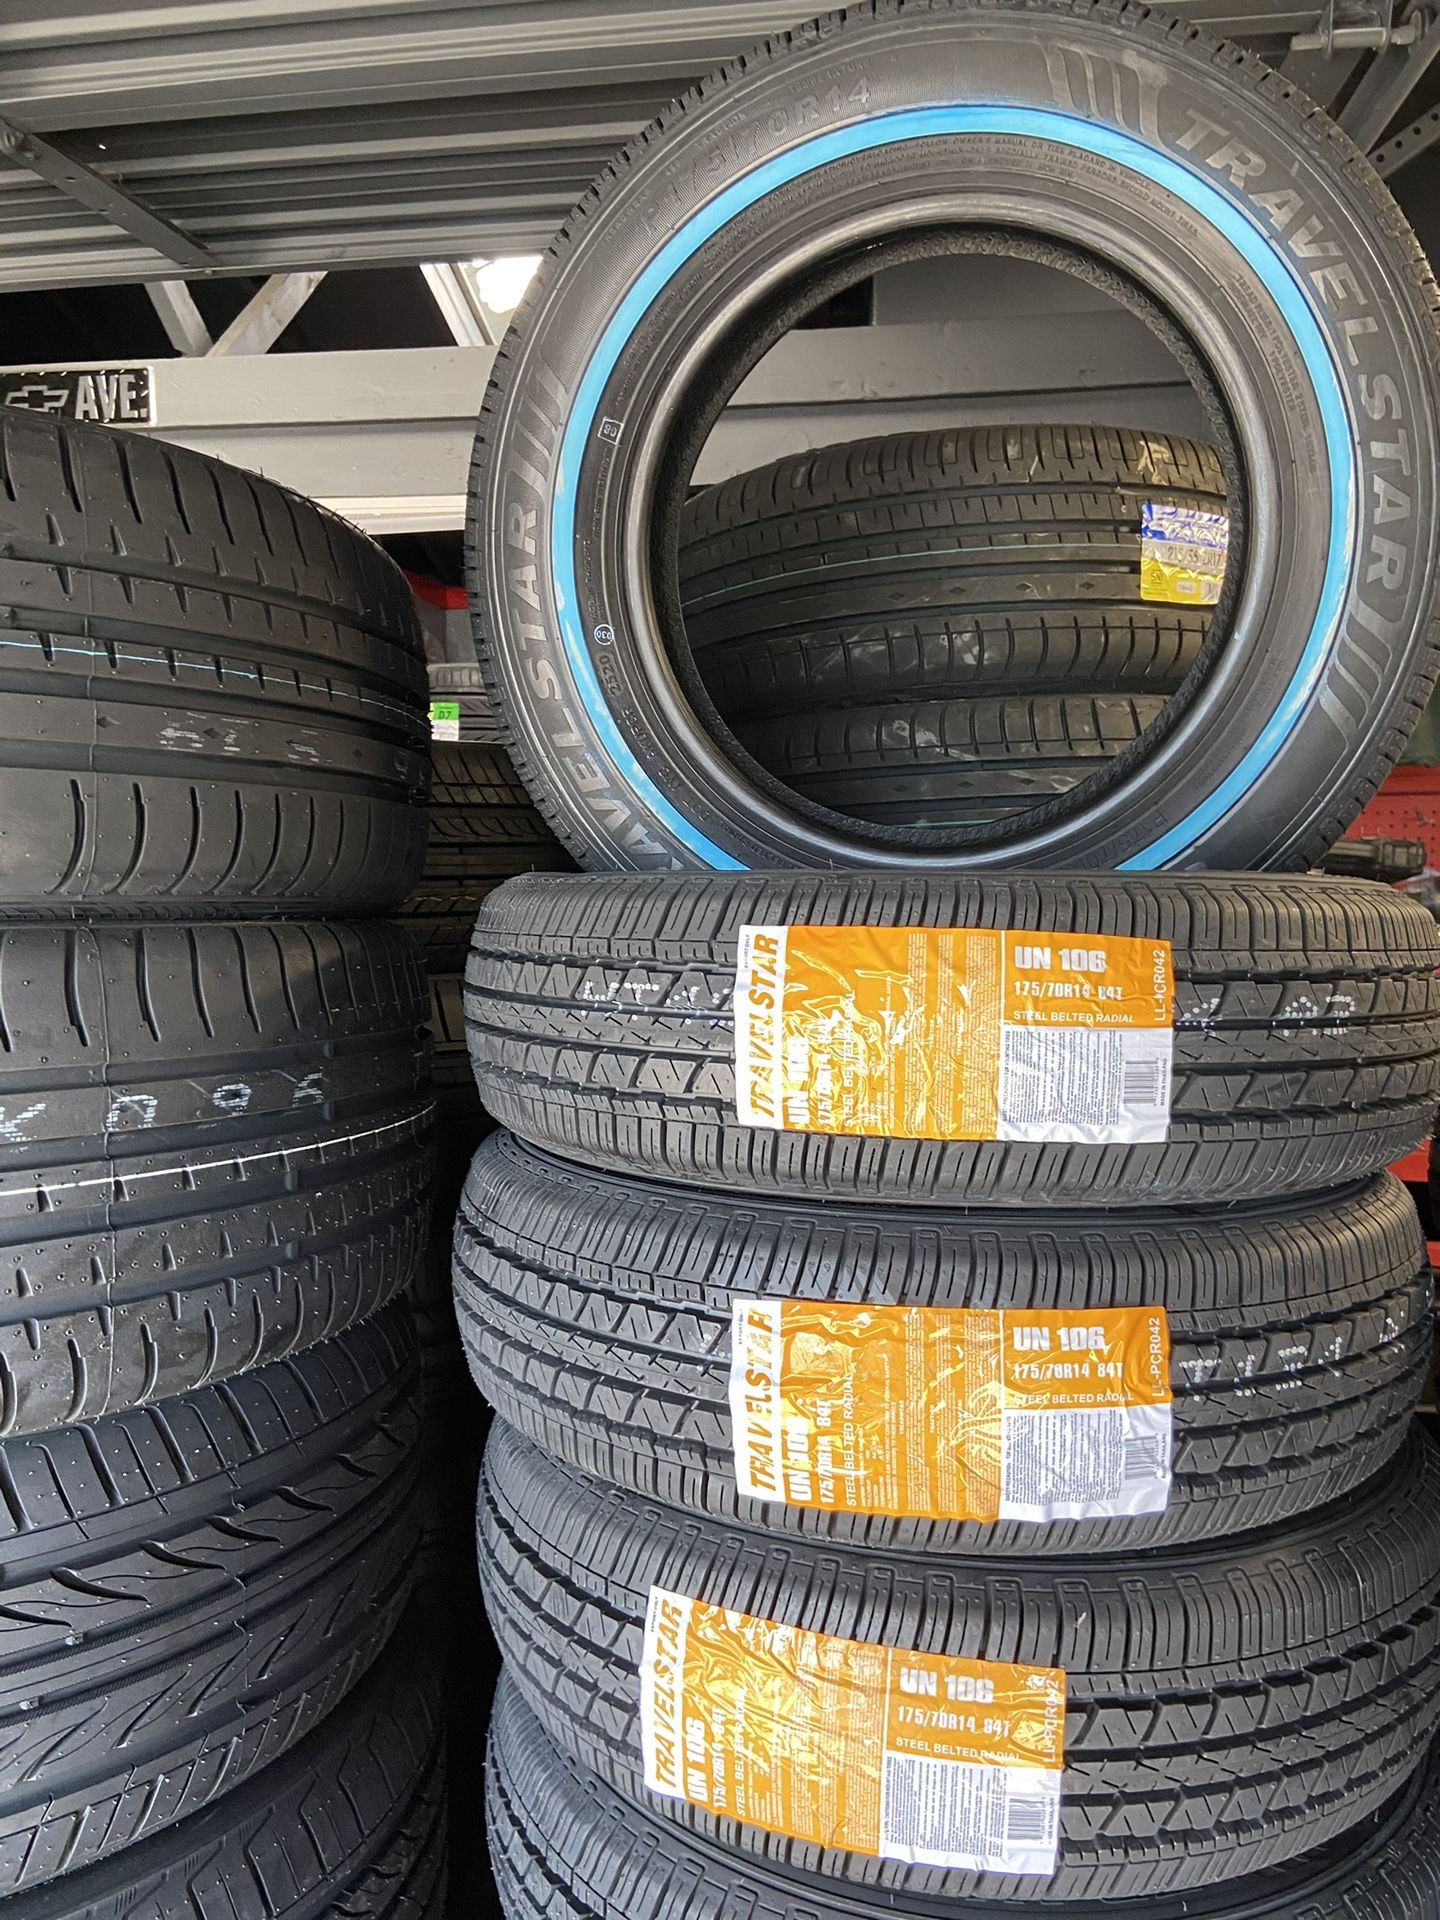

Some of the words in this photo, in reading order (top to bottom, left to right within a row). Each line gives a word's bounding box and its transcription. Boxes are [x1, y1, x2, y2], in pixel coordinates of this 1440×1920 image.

[1176, 108, 1413, 593] TRAVELSTAR
[75, 374, 148, 419] AVE.
[508, 504, 684, 870] AVELSTAR
[597, 652, 622, 697] 2520
[1014, 945, 1051, 971] UN
[1058, 948, 1106, 973] 106
[1014, 980, 1090, 1000] 175/70R14
[749, 933, 778, 1118] TRAVELSTAR
[1014, 1010, 1044, 1022] STEEL
[1050, 1011, 1093, 1023] BELTED
[1095, 1013, 1135, 1024] RADIAL
[788, 1090, 809, 1123] UN
[1014, 1326, 1050, 1351] UN
[1056, 1326, 1105, 1351] 106
[1149, 1316, 1165, 1398] LL-PCR042
[1014, 1363, 1089, 1382] 175/70R14
[1097, 1362, 1124, 1379] 84T
[745, 1307, 776, 1492] TRAVELSTAR
[815, 1399, 832, 1427] 84T
[843, 1374, 854, 1420] RADIAL
[1014, 1393, 1049, 1404] STEEL
[1051, 1393, 1094, 1404] BELTED
[1096, 1391, 1135, 1402] RADIAL
[844, 1423, 855, 1469] BELTED
[787, 1472, 812, 1501] UN
[816, 1436, 835, 1504] 175/70R14
[845, 1474, 857, 1507] STEEL
[653, 1599, 682, 1788] TRAVELSTAR
[900, 1667, 938, 1697] UN
[945, 1674, 995, 1705] 106
[685, 1717, 707, 1764] 106
[897, 1706, 977, 1736] 175/70R14
[982, 1719, 1012, 1738] 84T
[734, 1735, 745, 1781] BELTED
[896, 1737, 930, 1752] STEEL
[932, 1741, 978, 1757] BELTED
[979, 1748, 1021, 1761] RADIAL
[686, 1767, 709, 1802] UN
[712, 1743, 727, 1808] 175/70R14
[735, 1784, 746, 1817] STEEL
